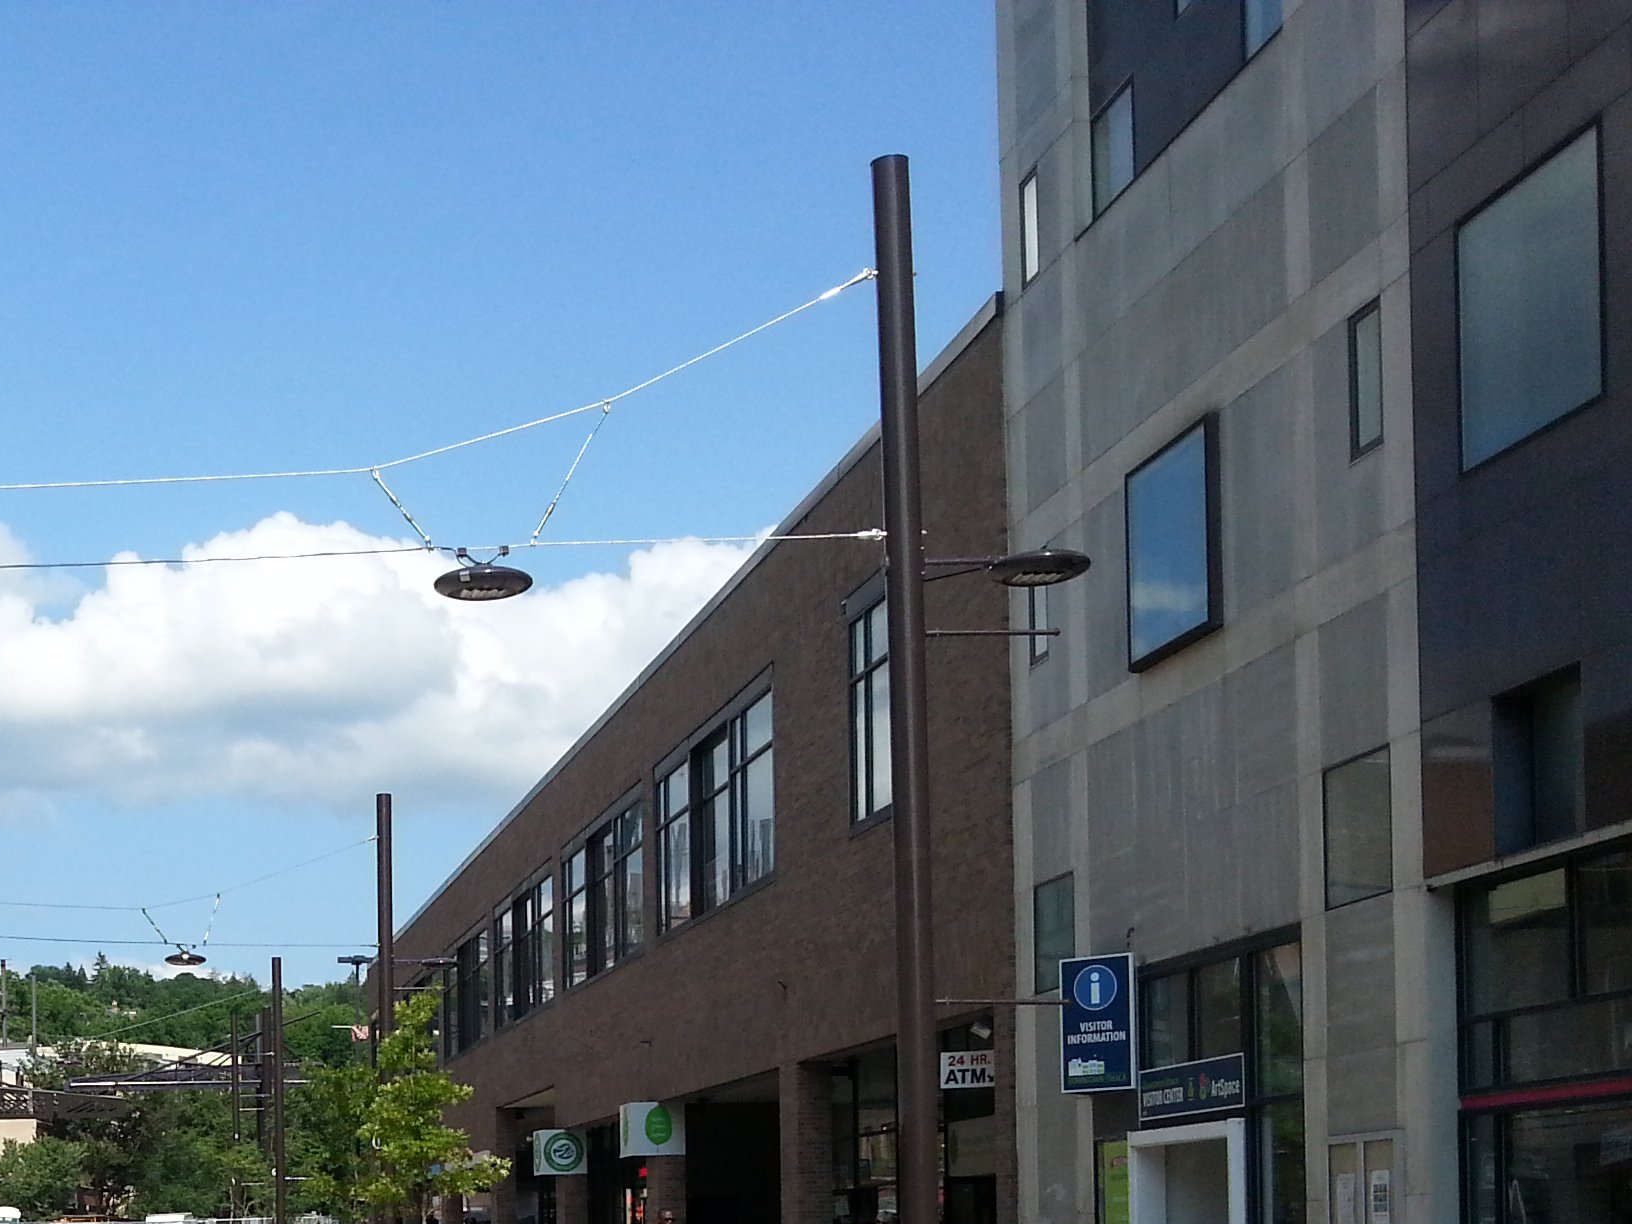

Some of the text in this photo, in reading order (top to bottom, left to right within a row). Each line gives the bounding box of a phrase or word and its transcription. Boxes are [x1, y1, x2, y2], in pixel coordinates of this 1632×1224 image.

[1080, 1020, 1113, 1033] VISITOR
[1067, 1031, 1126, 1045] INFORMATION
[948, 1055, 966, 1067] 24
[944, 1067, 986, 1085] ATM
[1210, 1078, 1240, 1099] ArtSpace
